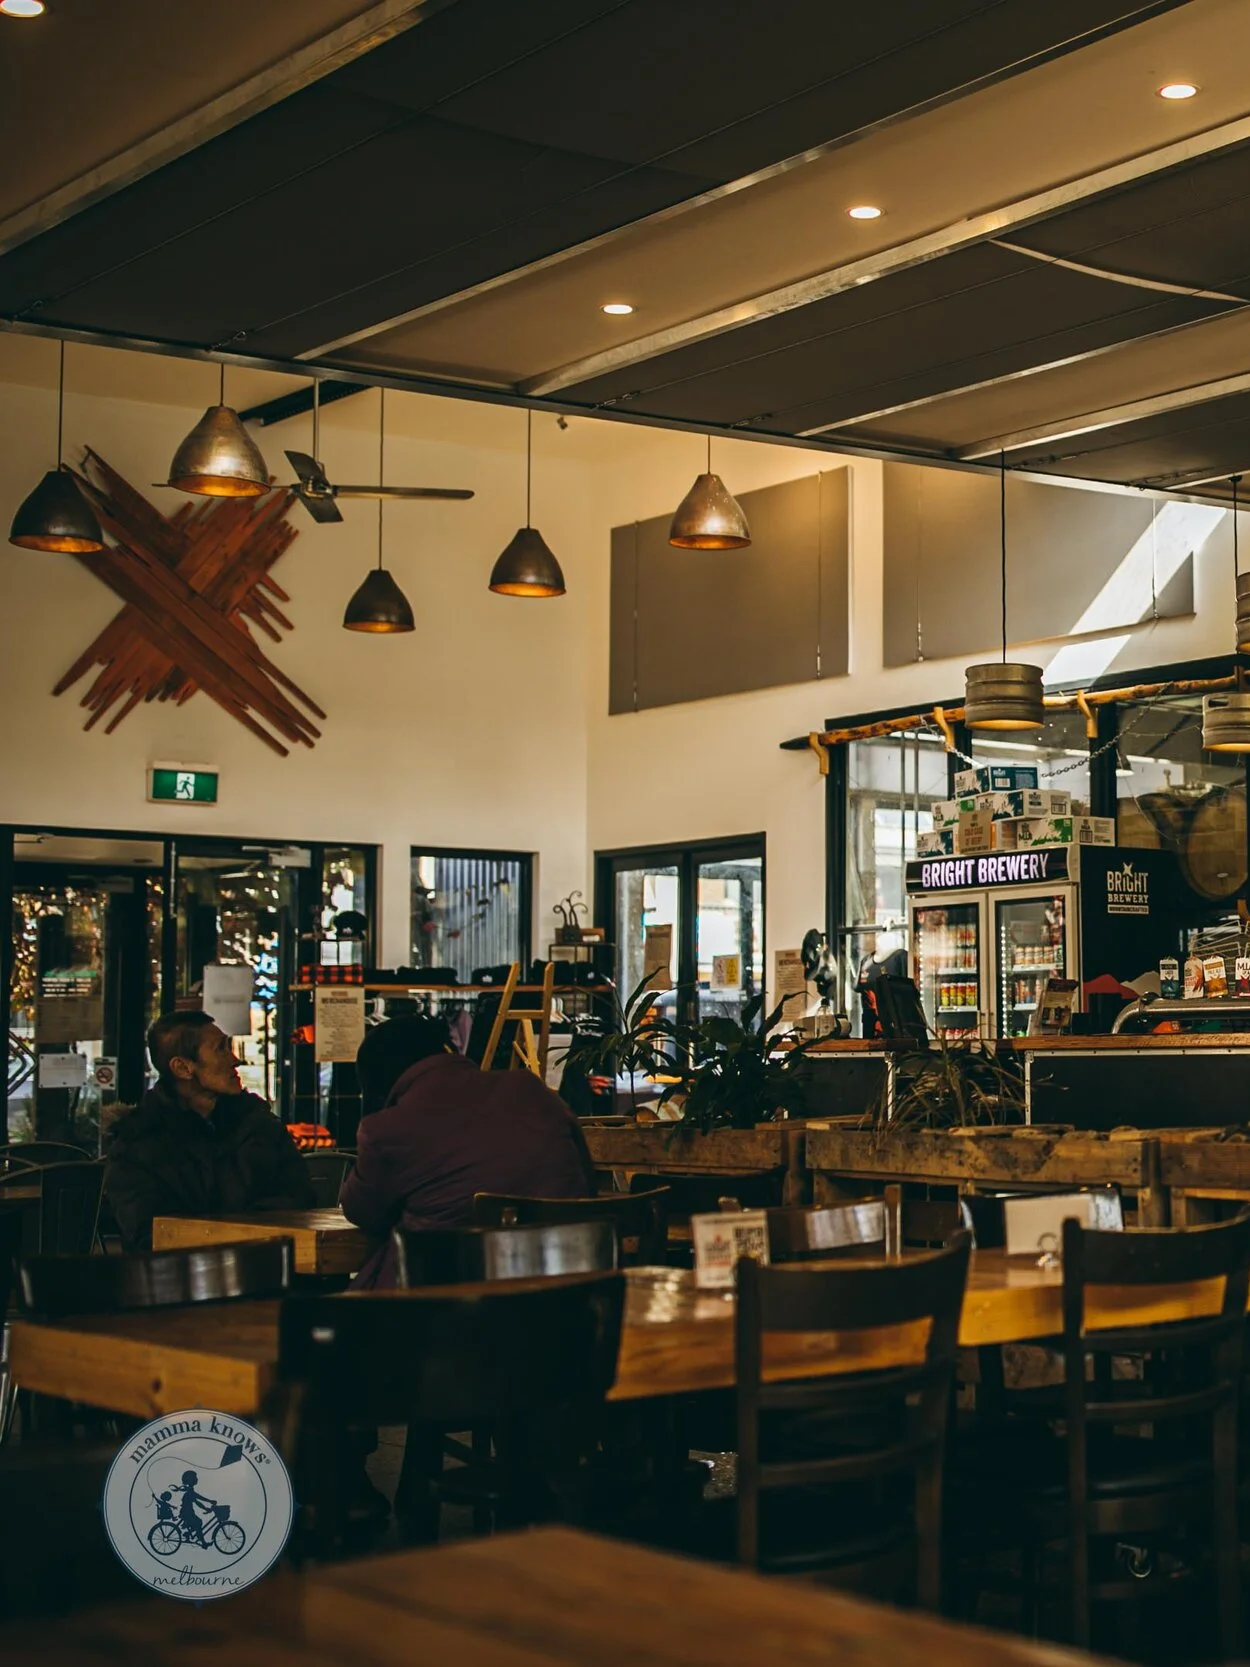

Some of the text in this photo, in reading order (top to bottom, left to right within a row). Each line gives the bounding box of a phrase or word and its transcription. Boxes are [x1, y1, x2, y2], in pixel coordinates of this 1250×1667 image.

[921, 852, 1050, 888] BRIGHT BREWERY
[1107, 871, 1149, 892] BRIGHT
[1107, 893, 1149, 903] BREWERY
